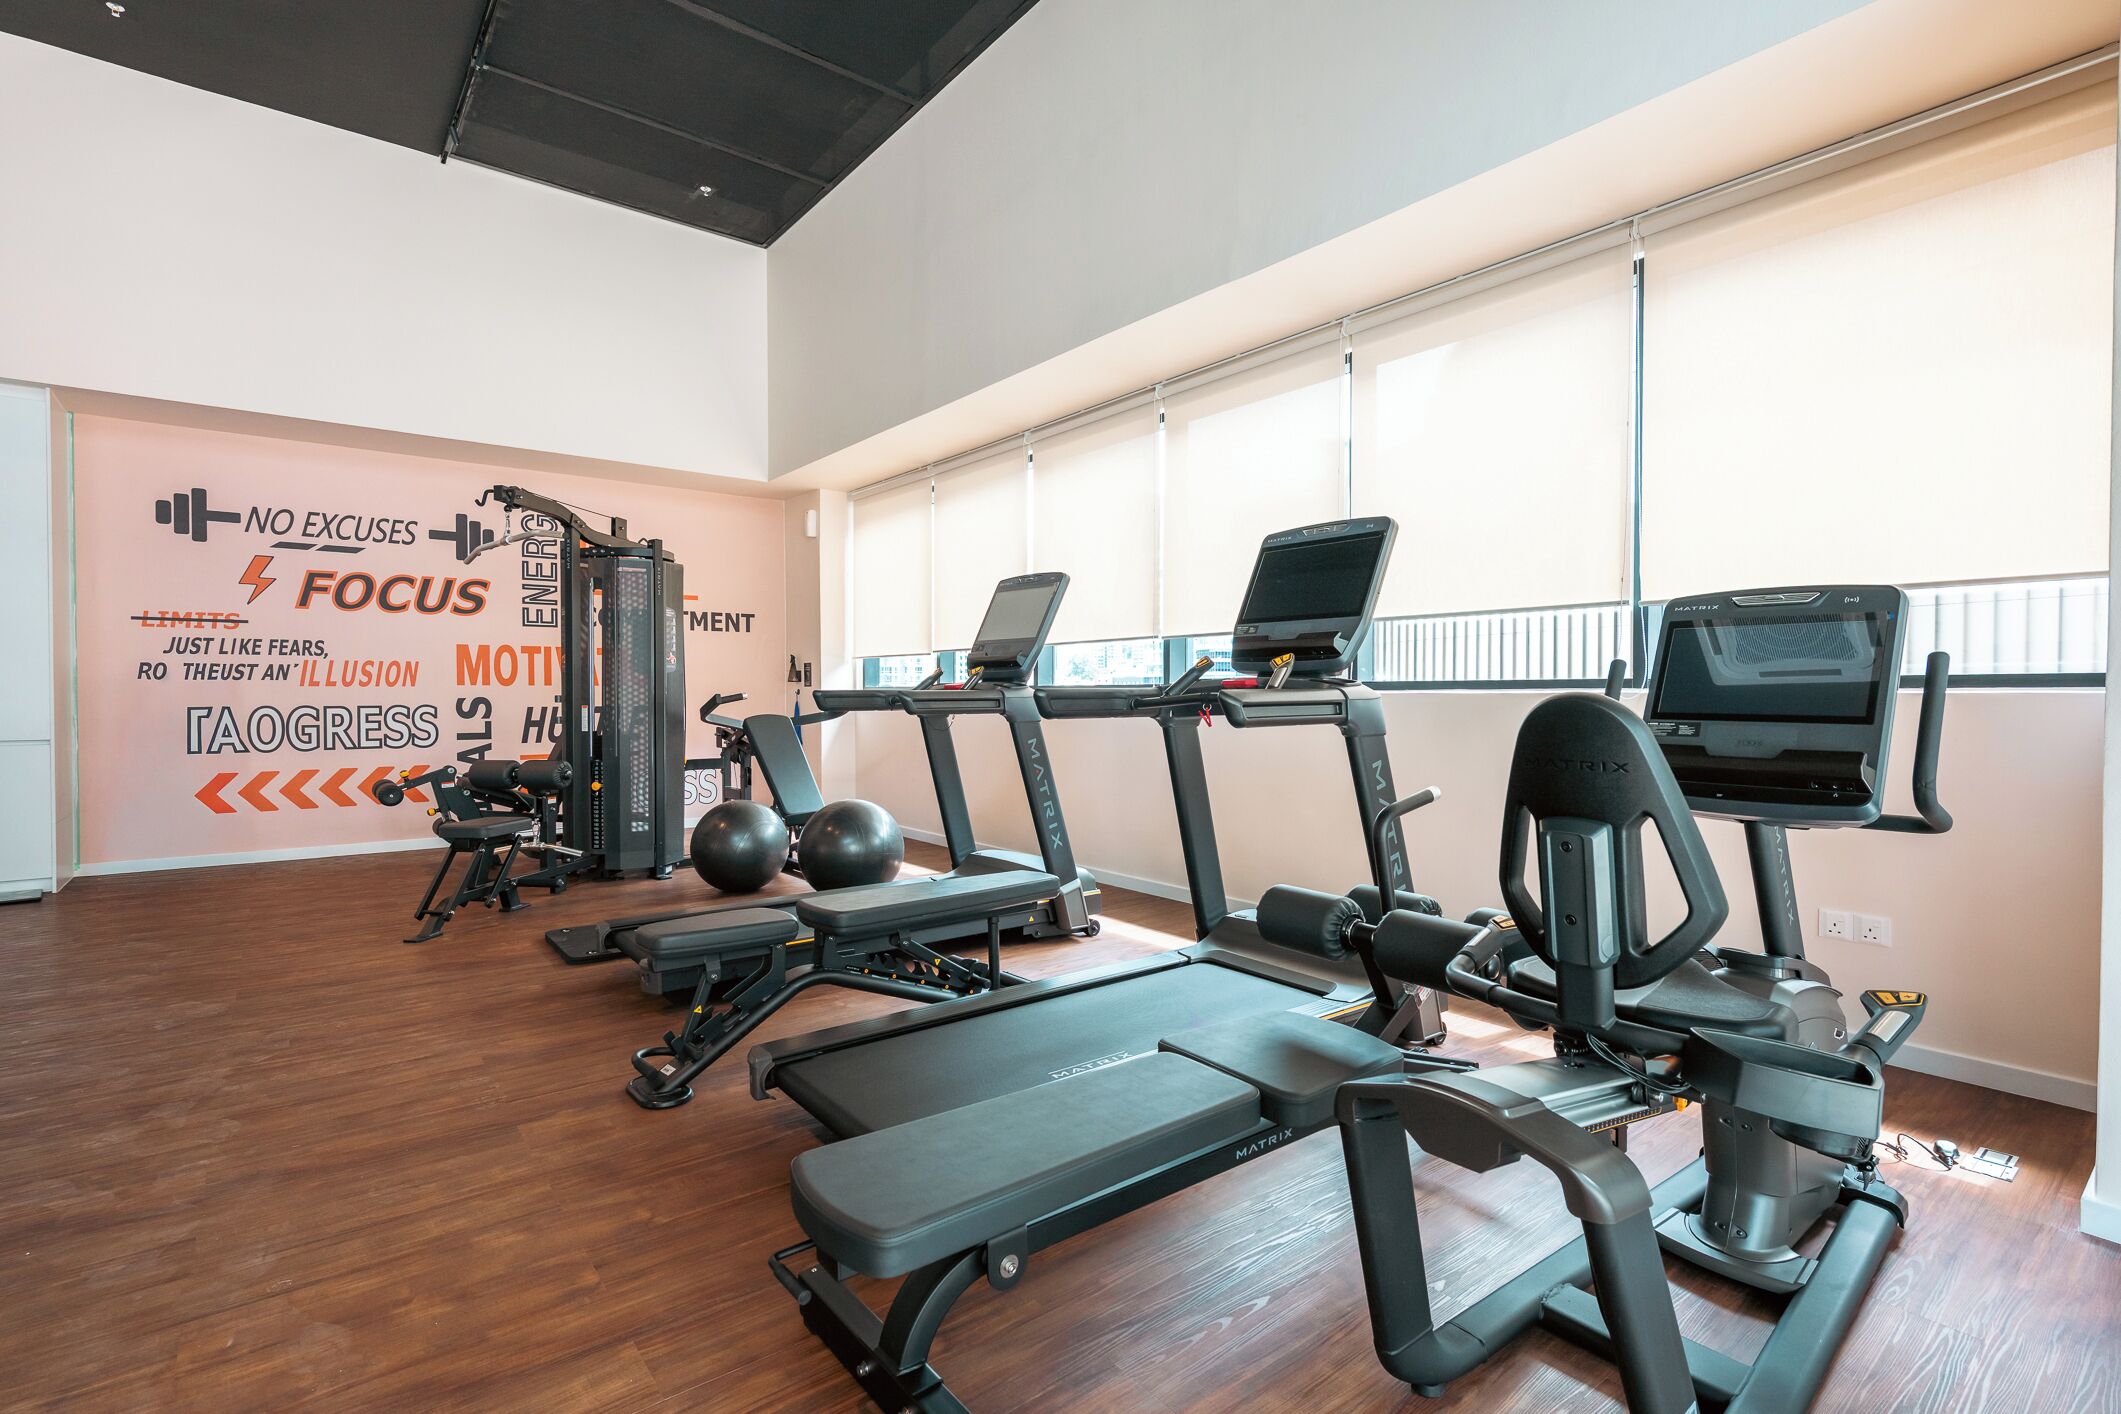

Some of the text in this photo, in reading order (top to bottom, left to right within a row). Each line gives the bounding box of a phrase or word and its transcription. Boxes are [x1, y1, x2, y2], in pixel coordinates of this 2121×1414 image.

[244, 506, 418, 545] NO EXCUSES
[520, 507, 559, 628] ENERG
[295, 569, 491, 617] FOCUS
[1673, 604, 1720, 612] MATRIX
[140, 610, 241, 630] LIMITS
[163, 636, 329, 660] JUST LIKE FEARS,
[137, 661, 168, 681] RO
[183, 662, 259, 681] THEUST
[299, 659, 419, 688] ILLUSION
[1524, 757, 1630, 774] MATRIX
[1027, 737, 1063, 850] MATRIX
[1774, 826, 1794, 927] MATRIX
[1051, 1052, 1133, 1079] MATRIX
[1235, 1127, 1293, 1160] MATRIX
